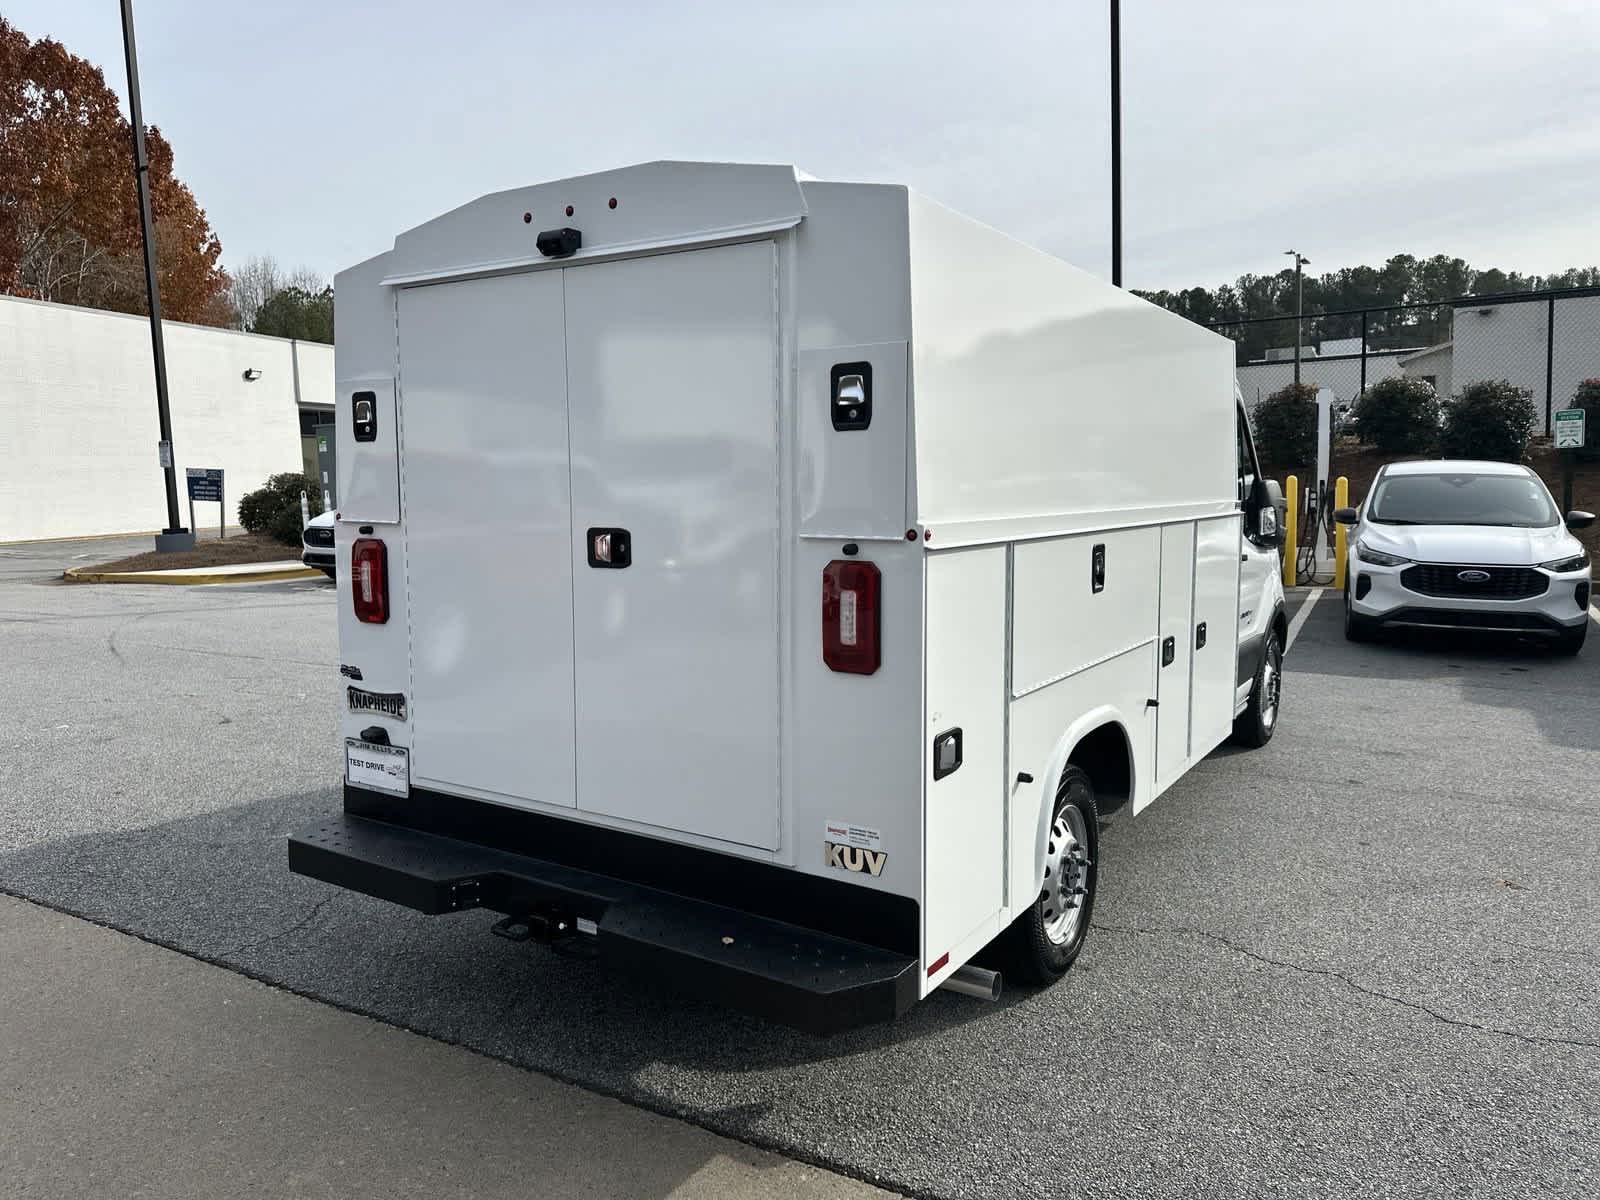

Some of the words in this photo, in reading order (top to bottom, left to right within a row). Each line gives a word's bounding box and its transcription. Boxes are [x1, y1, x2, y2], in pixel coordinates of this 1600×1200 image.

[349, 689, 404, 717] KNAPHEIDE
[372, 745, 392, 754] ELLIS
[349, 758, 364, 768] TEST
[365, 761, 385, 772] DRIVE
[824, 842, 888, 877] KUV
